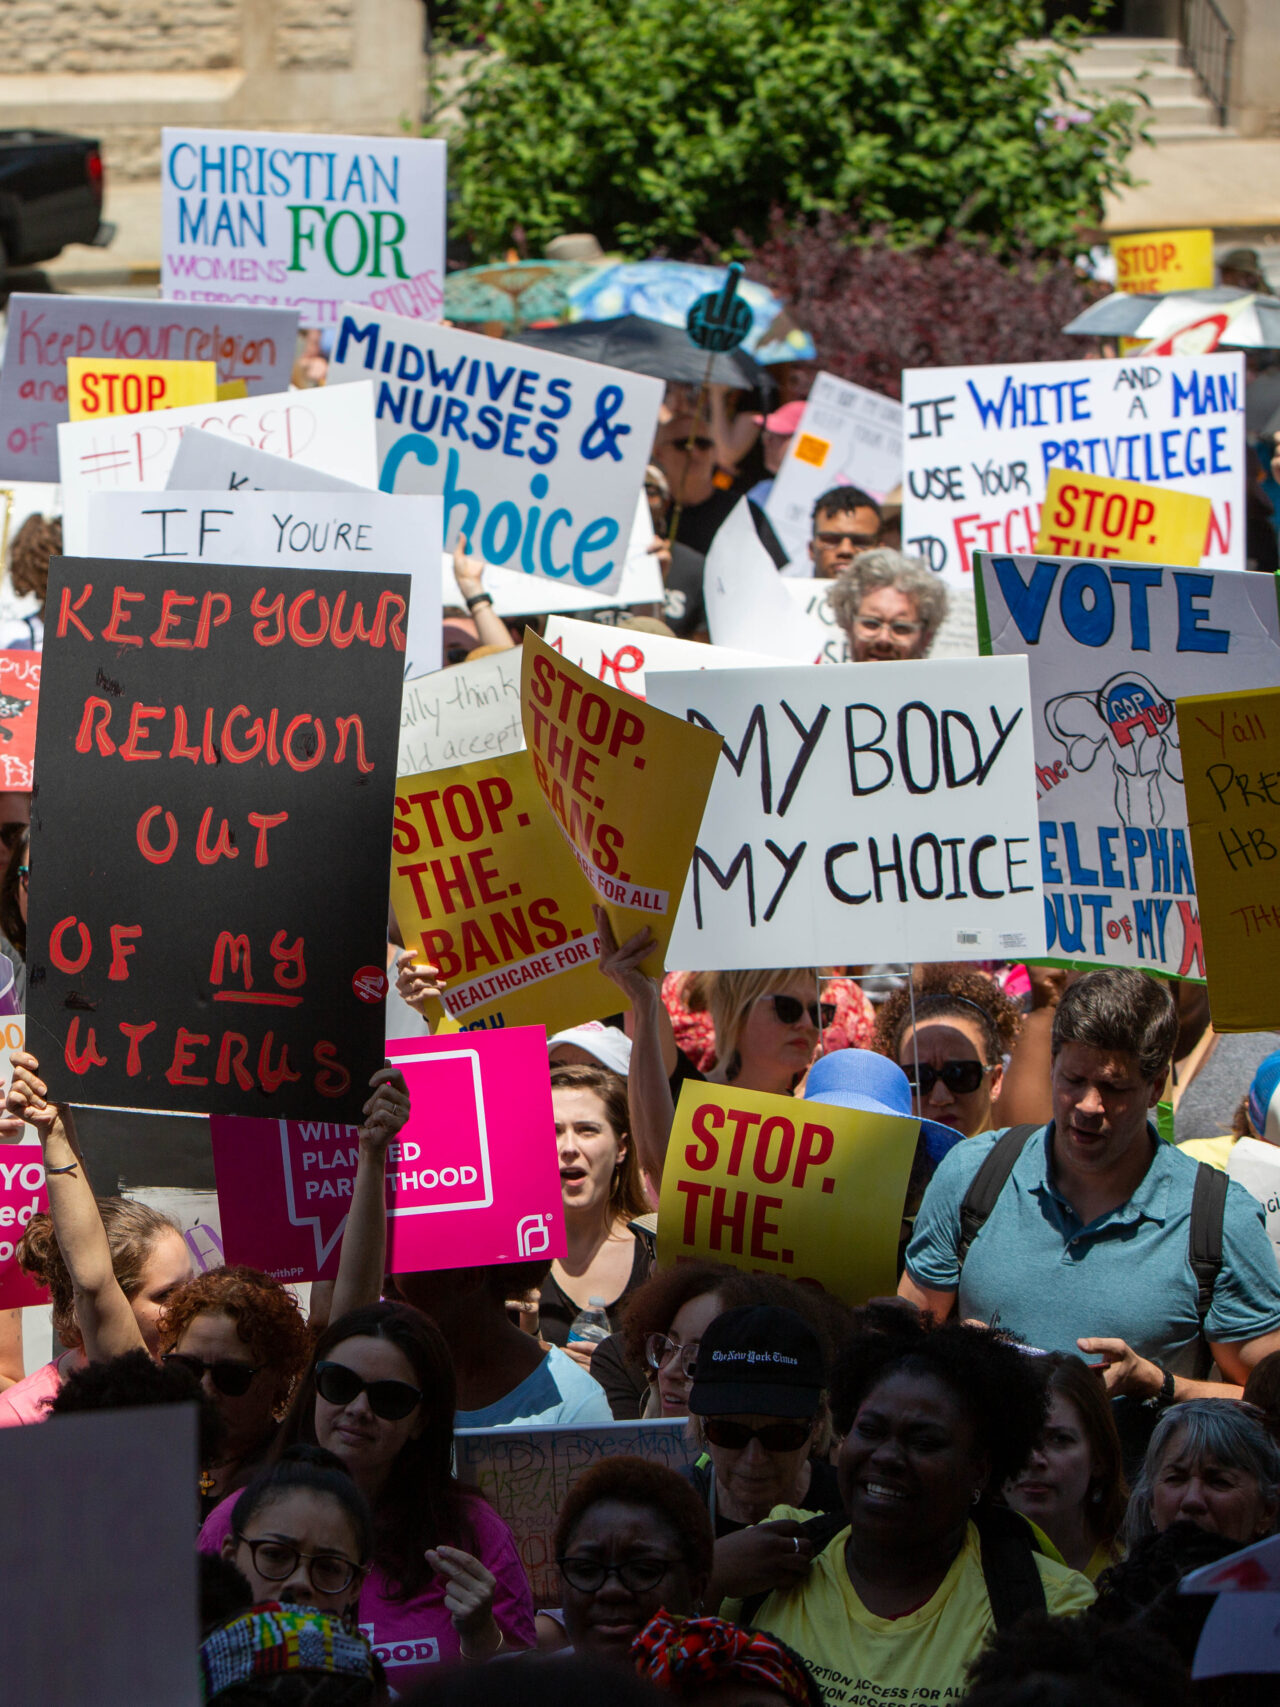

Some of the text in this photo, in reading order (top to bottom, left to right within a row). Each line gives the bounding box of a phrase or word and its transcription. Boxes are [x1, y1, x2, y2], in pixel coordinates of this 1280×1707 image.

[168, 142, 400, 203] CHRISTIAN
[167, 254, 287, 283] WOMENS
[179, 197, 411, 279] MAN FOR
[1119, 242, 1181, 275] STOP.
[20, 311, 95, 366] Keep
[80, 373, 172, 414] STOP.
[334, 316, 631, 461] MIDWIVES &
[967, 376, 1091, 430] WHITE
[1113, 367, 1161, 390] AND
[1128, 397, 1148, 418] A
[375, 382, 558, 464] NURSES
[908, 396, 956, 439] IF
[379, 433, 619, 586] Choice
[908, 466, 965, 500] USE
[971, 459, 1031, 495] YOUR
[141, 509, 373, 558] IF YOU'RE
[1053, 483, 1157, 545] STOP.
[908, 535, 946, 571] TO
[56, 583, 407, 653] KEEP YOUR
[992, 558, 1231, 653] VOTE
[446, 666, 520, 709] think
[530, 654, 646, 770] STOP.
[1110, 692, 1145, 723] GOP
[76, 695, 375, 774] RELIGION
[528, 700, 605, 810] THE.
[687, 700, 1022, 817] MY BODY
[136, 805, 289, 868] OUT
[392, 777, 530, 855] STOP.
[533, 750, 631, 883] BANS.
[693, 832, 1034, 929] MY CHOICE
[1039, 821, 1197, 895] ELEPHA
[1218, 827, 1277, 872] HB
[397, 848, 521, 919] THE.
[598, 875, 662, 910] FOR ALL
[49, 915, 142, 982] OF
[421, 898, 582, 980] BANS.
[1107, 917, 1133, 944] OF
[1133, 899, 1171, 963] MY
[445, 945, 589, 1015] HEALTHCARE FOR
[65, 1016, 352, 1098] UTERUS
[298, 1122, 358, 1142] WITH
[303, 1141, 421, 1171] PLANED
[685, 1103, 835, 1194] STOP.
[305, 1165, 478, 1200] PARTHOOD
[677, 1180, 794, 1264] THE.
[712, 1350, 798, 1365] The New York Times
[464, 1433, 632, 1463] Black Lives
[801, 1657, 852, 1688] ORTION
[855, 1679, 909, 1699] ACCESS
[912, 1687, 940, 1700] FOR
